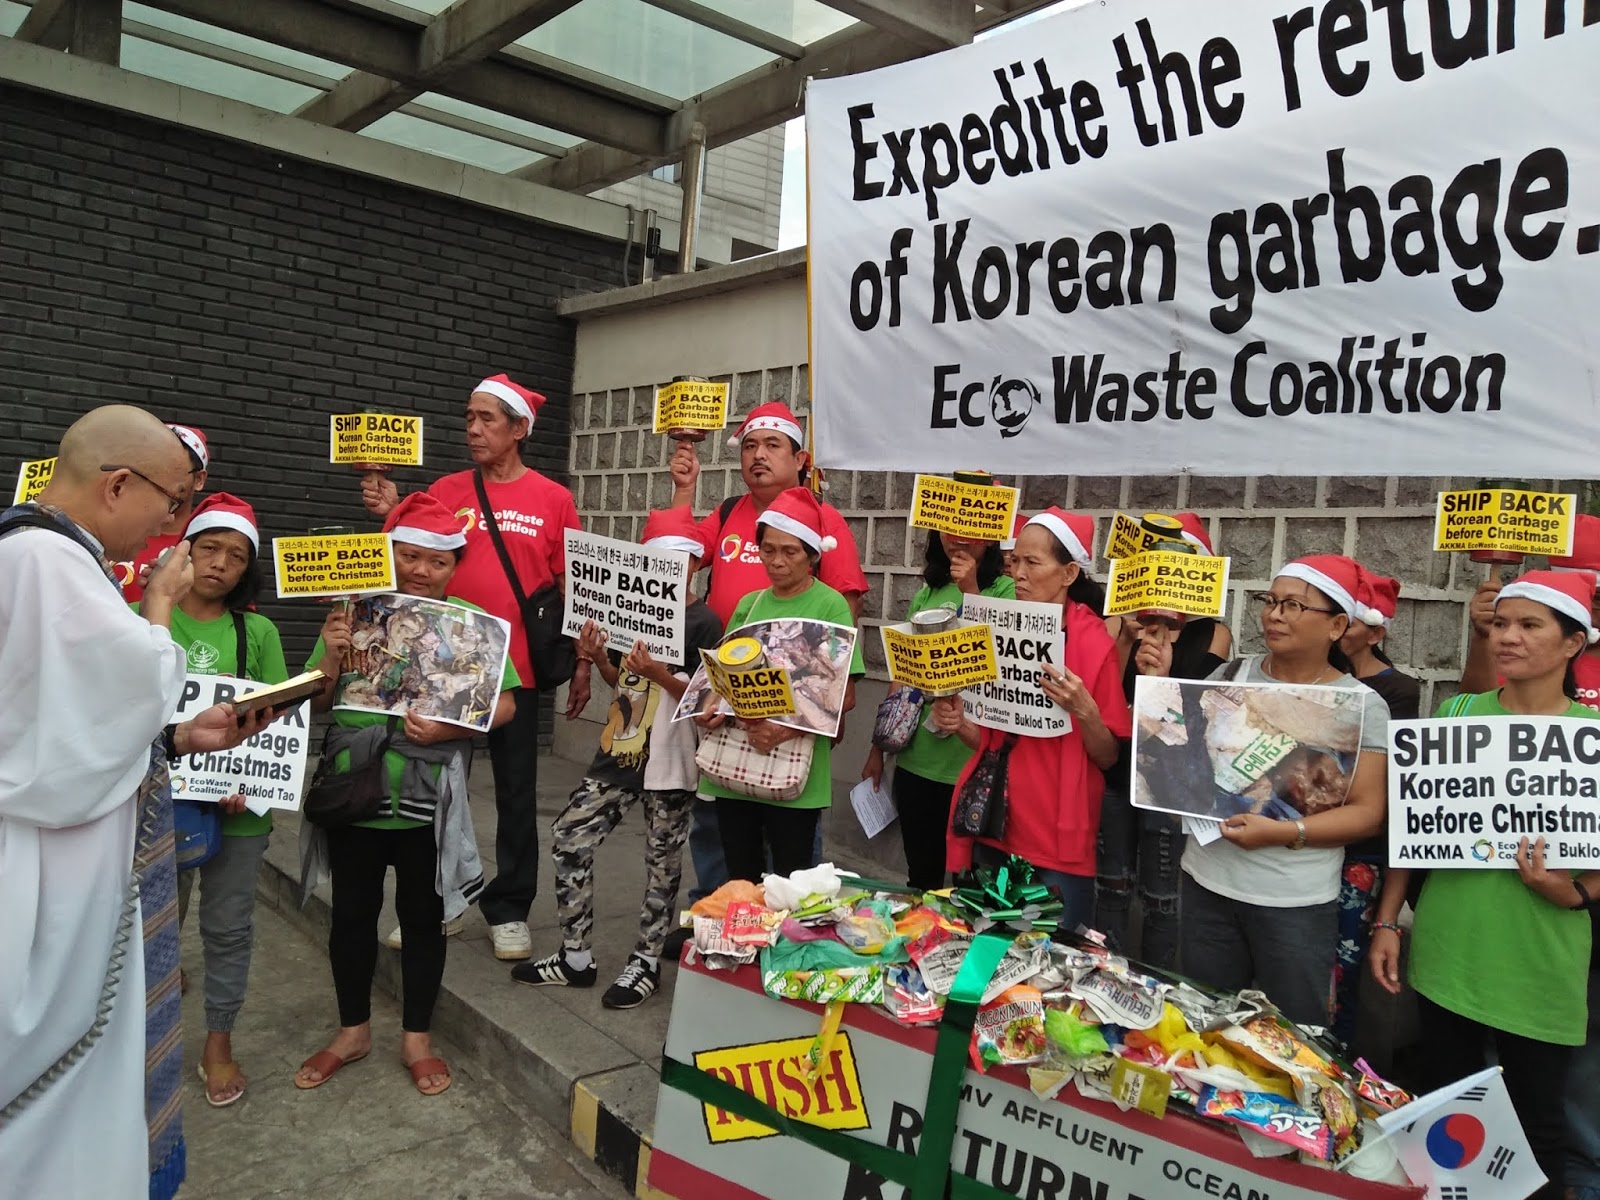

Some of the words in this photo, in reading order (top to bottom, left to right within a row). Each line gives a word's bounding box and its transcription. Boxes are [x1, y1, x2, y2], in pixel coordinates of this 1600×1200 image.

[848, 57, 1108, 219] Expedite
[1114, 17, 1245, 148] the
[1273, 0, 1600, 112] retu
[850, 228, 913, 332] of
[932, 217, 1175, 324] Korean
[1052, 350, 1217, 424] Waste
[1230, 332, 1507, 418] Coalition
[660, 395, 676, 408] SHIP
[680, 394, 722, 403] BACK
[679, 403, 720, 412] Garbage
[674, 411, 720, 420] Christmas
[335, 416, 361, 431] SHIP
[367, 416, 416, 434] BACK
[339, 433, 362, 442] Korean
[366, 432, 412, 446] Garbage
[339, 444, 358, 454] before
[360, 443, 412, 455] Christmas
[26, 461, 53, 479] SH
[28, 479, 50, 490] Kor
[921, 490, 956, 503] SHIP
[961, 498, 1009, 511] BACK
[1443, 492, 1492, 512] SHIP
[1500, 492, 1566, 516] BACK
[922, 500, 956, 514] Korean
[959, 508, 1005, 521] Garbage
[920, 509, 950, 522] before
[952, 516, 1003, 530] Christmas
[1447, 514, 1492, 526] Korean
[1498, 513, 1560, 531] Garbage
[479, 520, 537, 537] Clition
[914, 520, 937, 528] AKKMA
[958, 529, 981, 537] Coalition
[1116, 516, 1141, 541] SHIP
[1446, 527, 1483, 540] before
[1488, 527, 1558, 544] Christmas
[278, 541, 309, 550] 크리스마스
[326, 540, 338, 548] 한국
[1115, 532, 1137, 555] Korean
[1500, 542, 1528, 551] Coalition
[1530, 546, 1552, 554] Buklod
[283, 551, 329, 562] SHIP
[337, 548, 384, 560] BACK
[568, 540, 595, 558] 크리스마스
[597, 545, 608, 563] 전에
[610, 549, 621, 566] 한국
[622, 552, 649, 572] 쓰레기를
[651, 557, 683, 578] 가져가라!
[1164, 555, 1189, 566] 쓰레기를
[287, 564, 331, 572] Korean
[336, 561, 383, 570] Garbage
[1116, 566, 1150, 583] SHIP
[1157, 566, 1217, 583] BACK
[288, 574, 325, 582] before
[329, 570, 384, 581] Christmas
[571, 560, 611, 586] SHIP
[618, 572, 678, 602] BACK
[1117, 579, 1149, 592] Korean
[1154, 578, 1213, 593] Garbage
[573, 581, 612, 606] Korean
[616, 594, 674, 621] Garbage
[1115, 591, 1142, 603] before
[1146, 587, 1212, 603] Christmas
[1109, 604, 1130, 613] AKKMA
[1156, 601, 1183, 610] Coalition
[1185, 605, 1206, 614] Buklod
[1208, 607, 1218, 615] Tao
[572, 599, 605, 622] before
[608, 610, 674, 639] Christmas
[998, 610, 1022, 631] 쓰레기를
[1024, 613, 1056, 635] 가져가라!
[567, 620, 582, 634] AKK
[610, 631, 634, 643] EcoWaste
[647, 642, 663, 655] klod
[665, 646, 679, 658] Tao
[918, 639, 931, 647] 한국
[932, 634, 958, 646] 쓰레기를
[890, 642, 923, 659] SHIP
[929, 640, 987, 660] BACK
[996, 635, 1053, 664] BACK
[894, 654, 926, 669] Korean
[930, 654, 986, 670] Garbage
[728, 671, 785, 688] BACK
[896, 663, 922, 680] before
[925, 663, 988, 680] Christmas
[937, 681, 964, 689] Coalition
[732, 689, 783, 699] Garbage
[983, 682, 1053, 709] Christmas
[731, 699, 787, 710] Christmas
[984, 705, 1010, 717] EcoWaste
[1015, 713, 1043, 729] Buklod
[1046, 718, 1065, 730] Tao
[984, 713, 1009, 724] Coalition
[246, 732, 300, 758] bage
[1394, 724, 1492, 767] SHIP
[1509, 724, 1600, 765] BAC
[189, 751, 292, 781] Christmas
[189, 786, 228, 795] Coalition
[190, 778, 232, 788] EcoWaste
[239, 783, 274, 798] Buklod
[278, 788, 294, 801] Tao
[1400, 772, 1495, 800] Korean
[1506, 768, 1598, 798] Garba
[1406, 806, 1483, 834] before
[1492, 803, 1600, 833] Christm
[1399, 844, 1464, 859] AKKMA
[1560, 842, 1600, 858] Buklo
[1002, 1100, 1143, 1166] AFFLUENT
[887, 1101, 1110, 1200] RTURN
